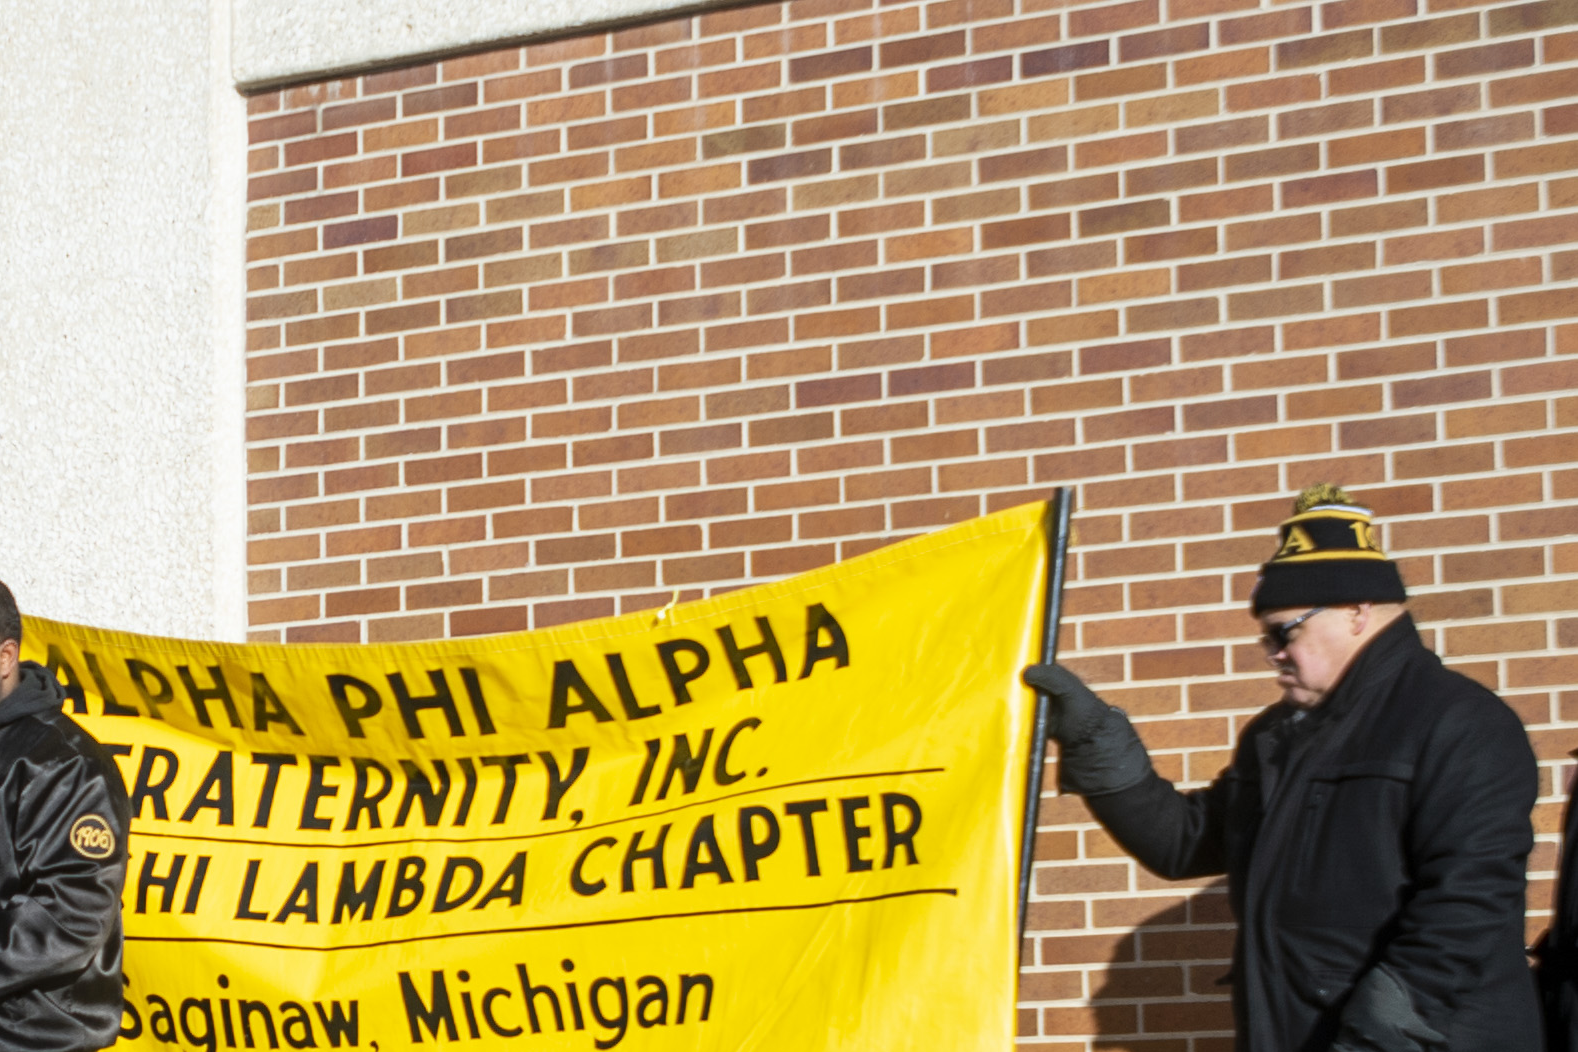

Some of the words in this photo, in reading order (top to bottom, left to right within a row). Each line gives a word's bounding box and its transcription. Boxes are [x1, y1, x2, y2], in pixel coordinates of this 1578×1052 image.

[45, 643, 305, 737] ALPHA
[326, 666, 497, 739] PHI
[545, 602, 851, 730] ALPHA
[628, 716, 769, 807] INC.
[75, 826, 111, 850] 1906
[121, 852, 212, 914] HI
[235, 851, 529, 925] LAMBDA
[568, 792, 923, 897] CHAPTER
[397, 958, 715, 1051] Michigan
